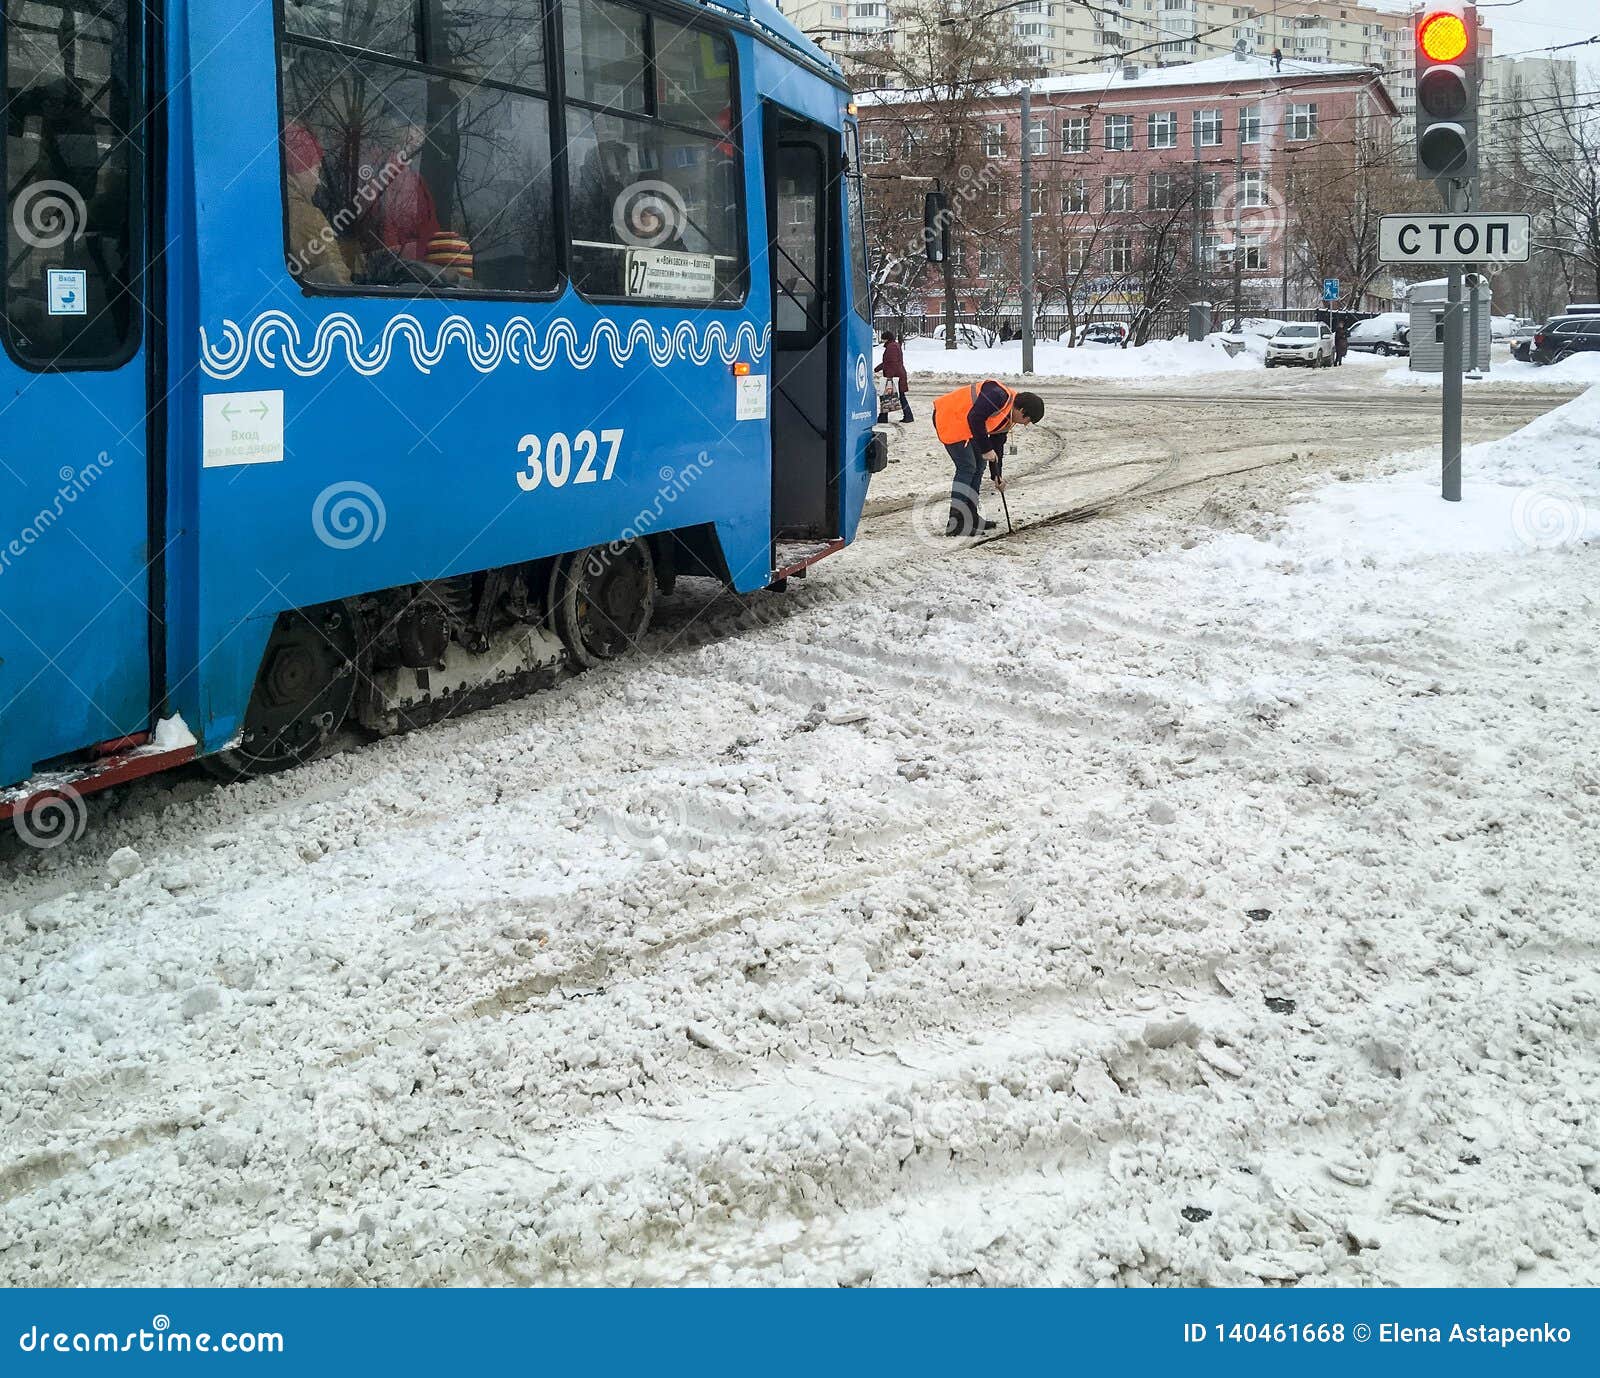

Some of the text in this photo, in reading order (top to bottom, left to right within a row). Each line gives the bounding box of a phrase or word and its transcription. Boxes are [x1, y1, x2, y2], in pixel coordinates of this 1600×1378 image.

[1398, 223, 1509, 255] СТОП
[631, 261, 648, 294] 27
[231, 430, 260, 442] Вход
[516, 428, 624, 492] 3027
